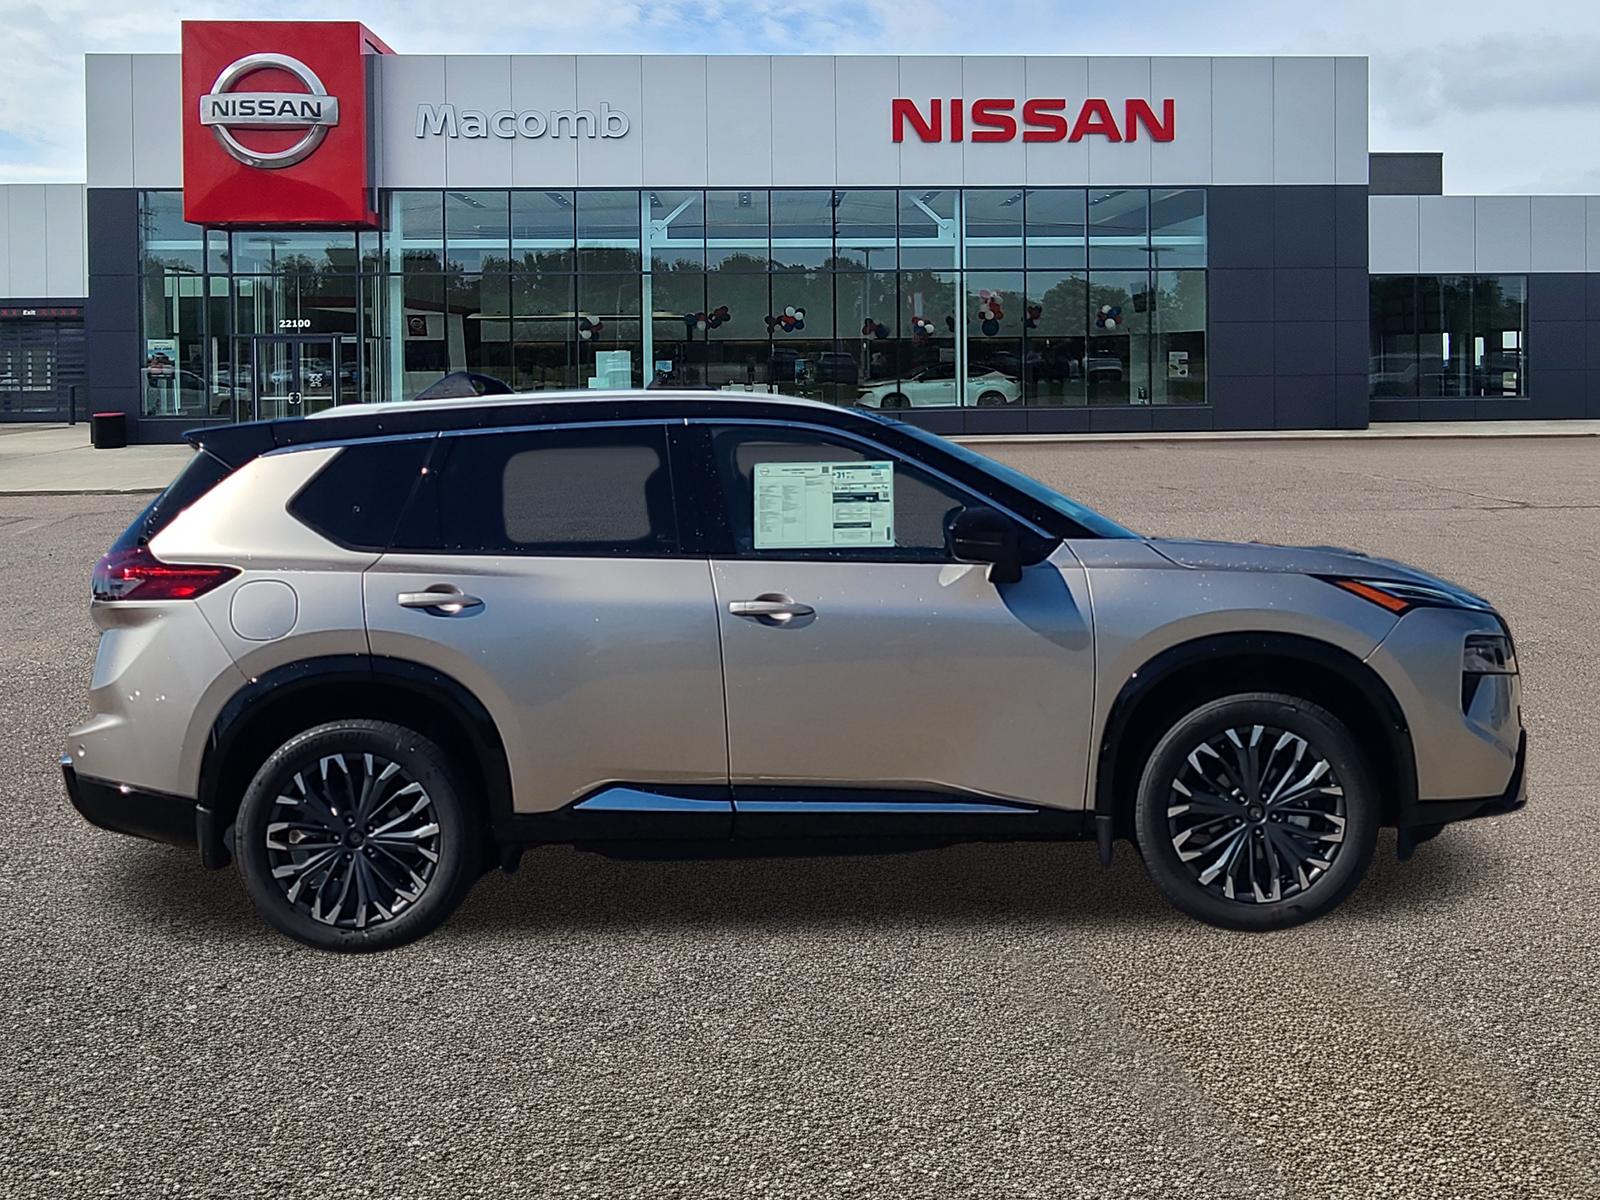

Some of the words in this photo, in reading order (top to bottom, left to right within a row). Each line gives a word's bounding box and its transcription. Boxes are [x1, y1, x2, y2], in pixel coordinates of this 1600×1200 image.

[212, 100, 321, 117] NISSAN
[415, 102, 630, 138] Macomb
[892, 98, 1175, 142] NISSAN
[279, 319, 311, 328] 22100
